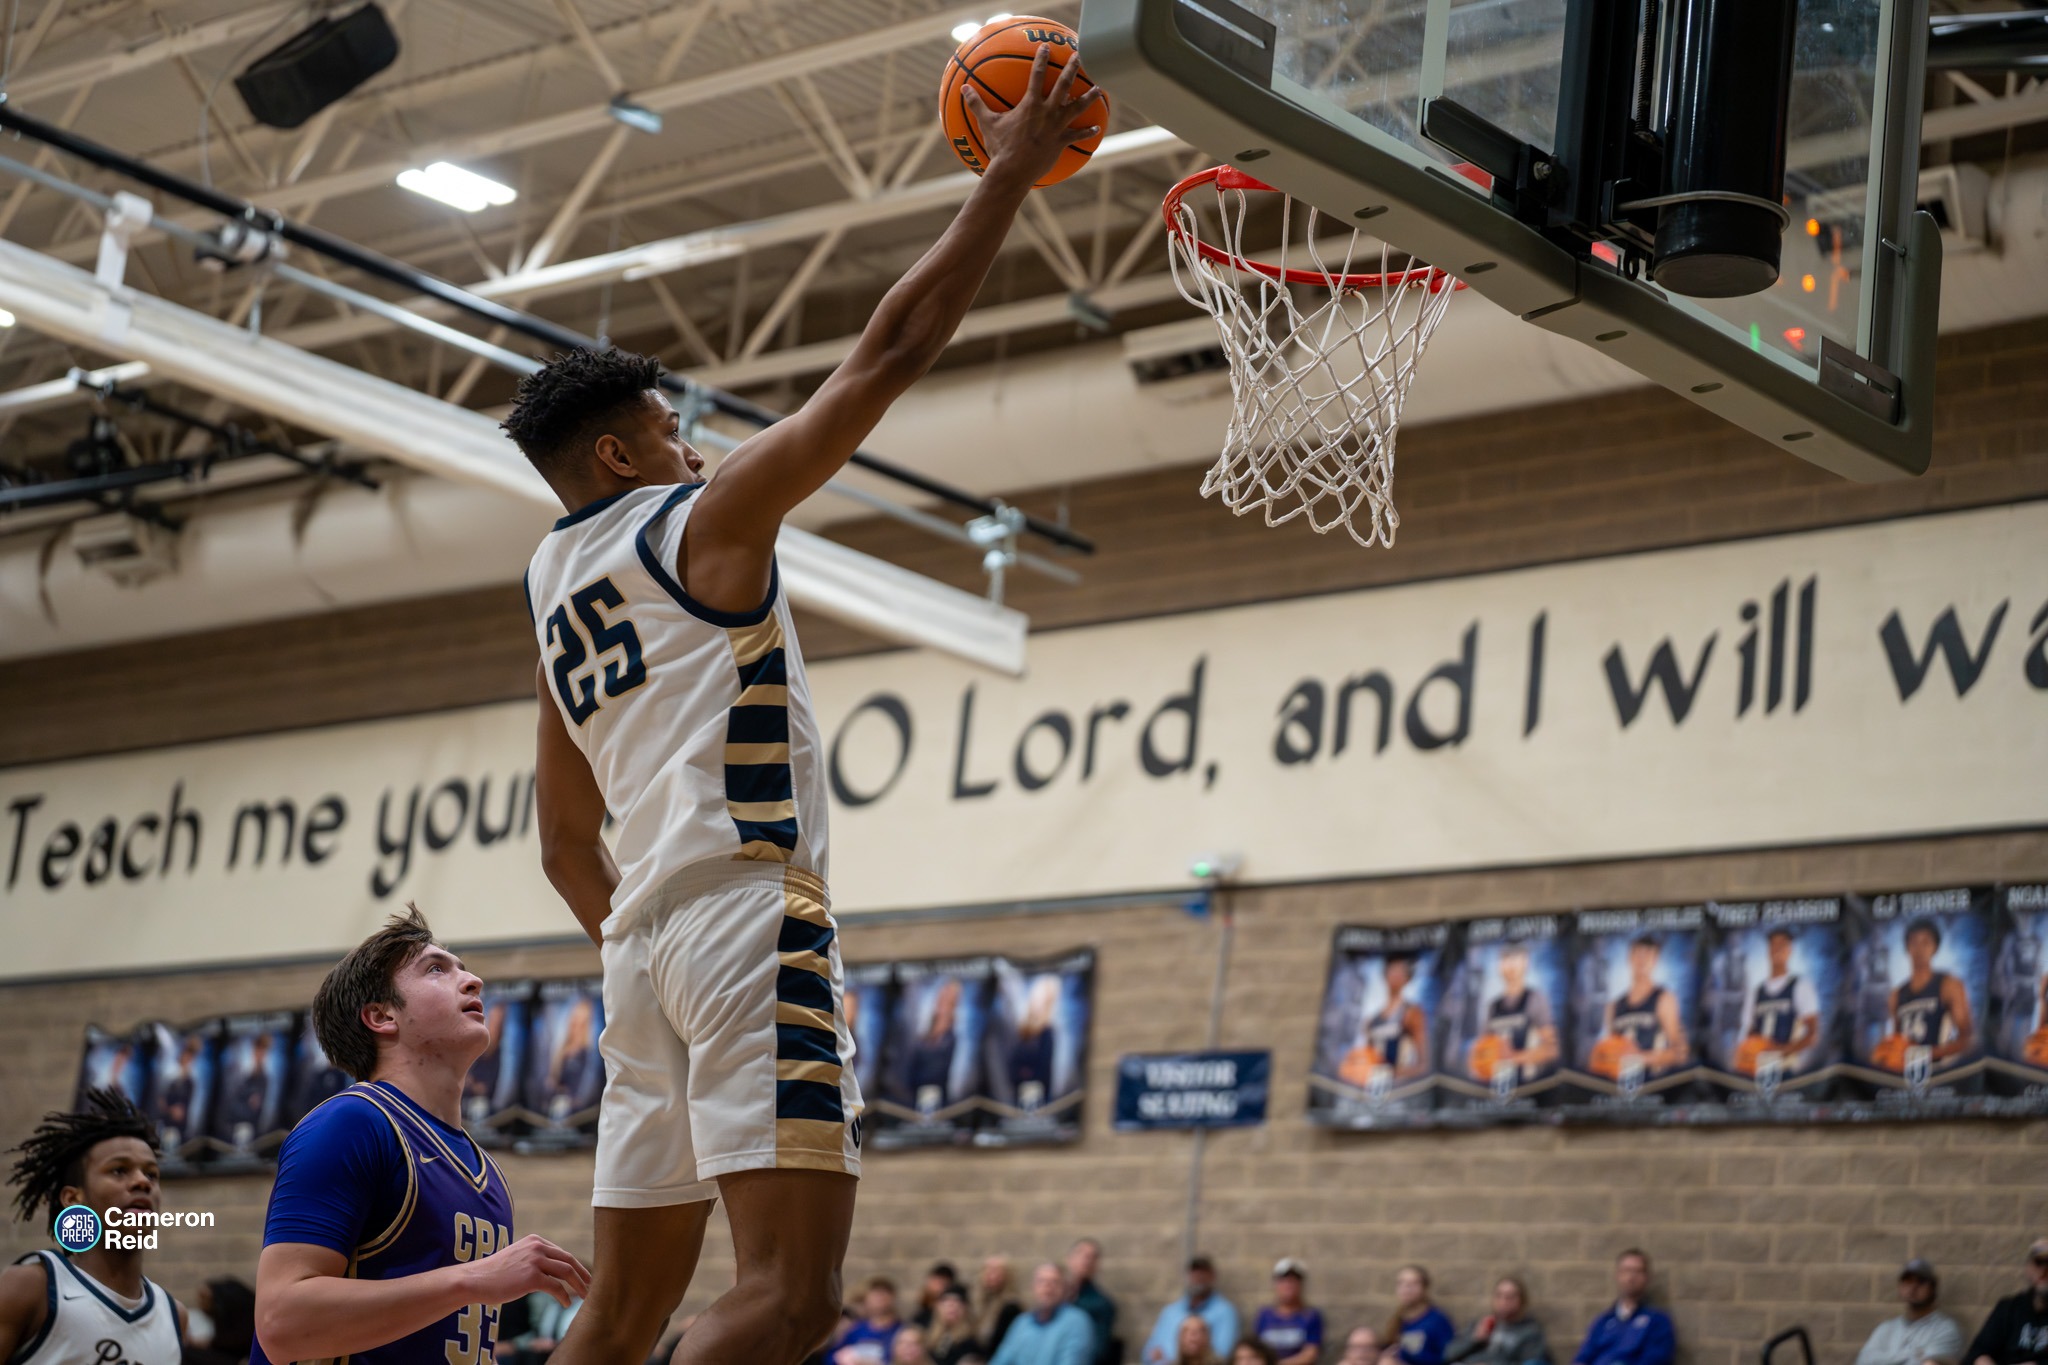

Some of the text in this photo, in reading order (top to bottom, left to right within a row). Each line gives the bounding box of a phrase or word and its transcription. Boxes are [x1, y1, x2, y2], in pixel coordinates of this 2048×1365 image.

[4, 778, 206, 896] Teach
[226, 794, 347, 872] me
[830, 692, 913, 807] O
[951, 653, 1220, 799] Lord,
[1273, 619, 1481, 767] and
[1522, 608, 1547, 739] I
[1602, 574, 1818, 731] will
[547, 573, 651, 728] 25
